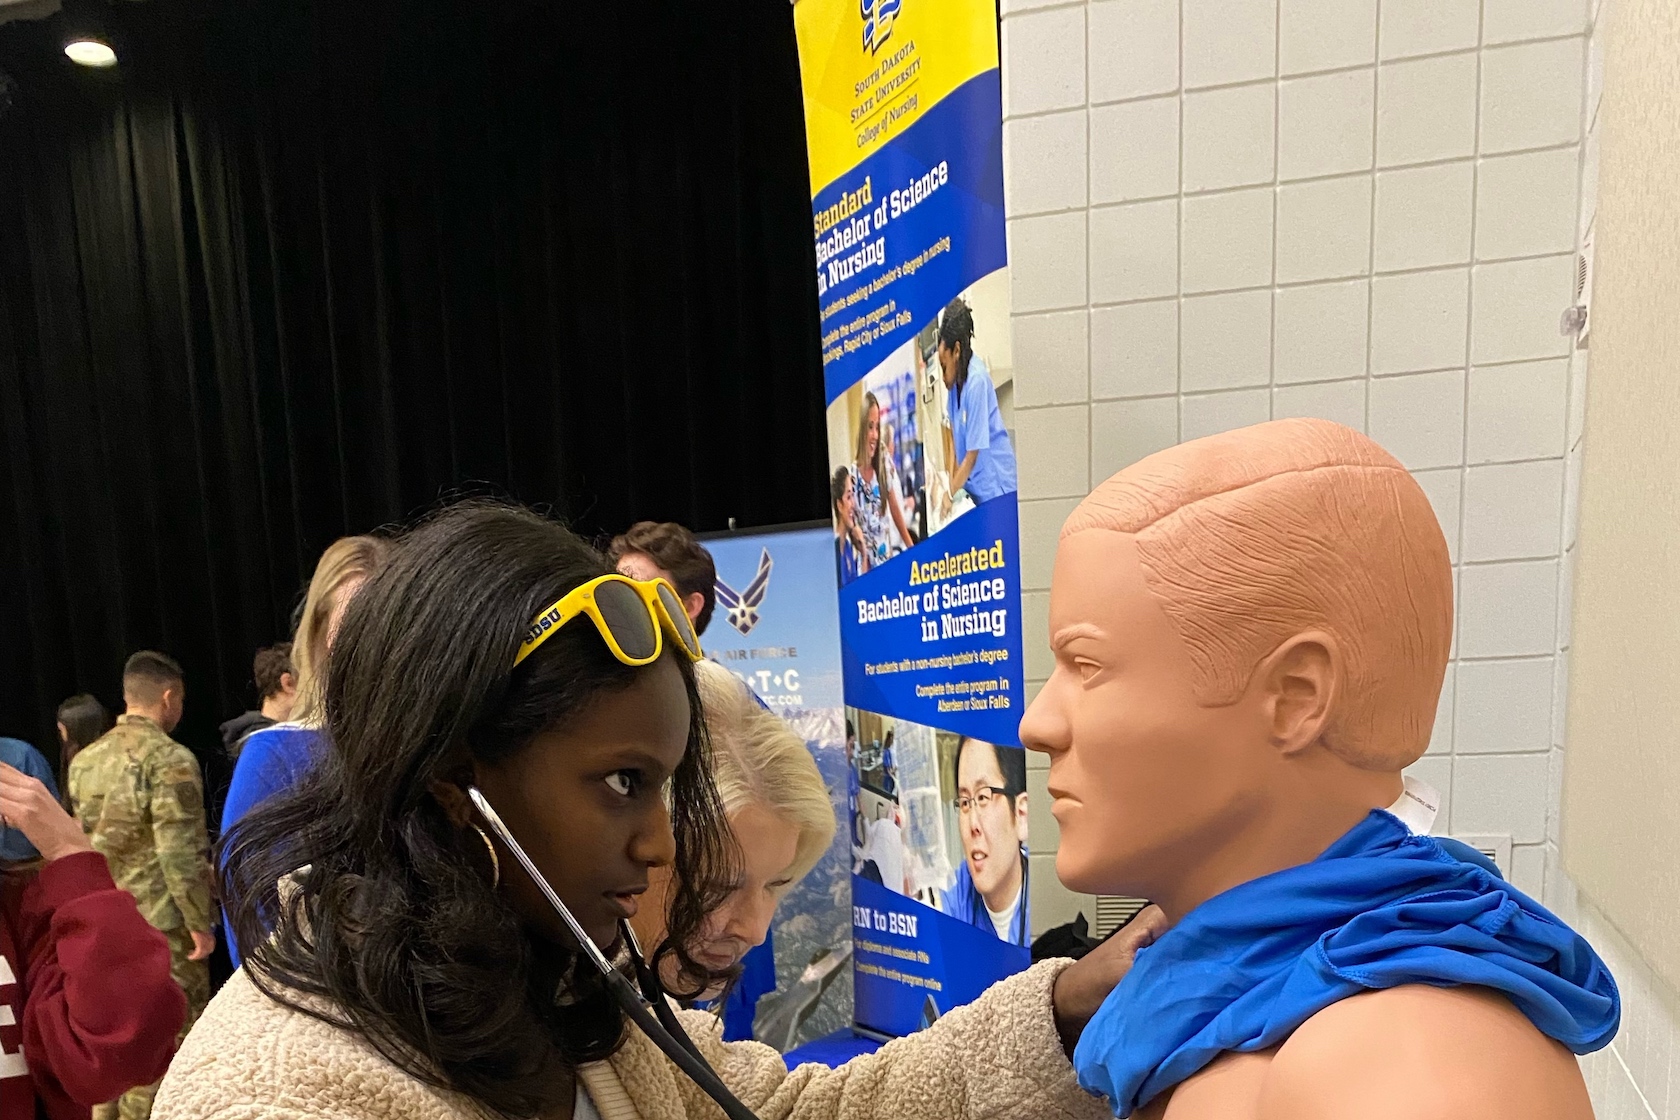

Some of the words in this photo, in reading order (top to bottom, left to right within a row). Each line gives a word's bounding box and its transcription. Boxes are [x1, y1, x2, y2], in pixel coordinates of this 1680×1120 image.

[850, 97, 874, 124] STATE
[875, 56, 921, 103] UNIVERSITY
[854, 68, 880, 98] SOUTH
[882, 40, 915, 75] DAKOTA
[857, 123, 880, 148] College
[881, 111, 888, 132] of
[889, 93, 918, 124] Nursing
[813, 175, 873, 240] Standard
[874, 196, 888, 230] of
[890, 160, 948, 219] Science
[828, 236, 885, 288] Nursing
[902, 254, 923, 275] degree
[928, 236, 950, 257] nursing
[844, 334, 861, 353] Rapid
[861, 330, 872, 345] City
[896, 310, 912, 327] Falls
[865, 304, 889, 328] program
[909, 539, 1005, 586] Accelerated
[857, 591, 920, 624] Bachelor
[923, 585, 939, 612] of
[942, 577, 1006, 609] Science
[921, 616, 939, 642] in
[941, 607, 1007, 639] Nursing
[725, 649, 747, 660] AIR
[865, 663, 875, 675] For
[876, 660, 899, 675] students
[899, 658, 911, 671] with
[916, 654, 952, 670] non-nursing
[979, 648, 1009, 666] degree
[915, 683, 945, 699] Complete
[945, 681, 955, 694] the
[955, 680, 969, 693] entire
[970, 680, 998, 696] program
[999, 676, 1010, 690] in
[937, 699, 963, 712] Aberdeen
[970, 696, 988, 711] Sioux
[988, 694, 1010, 709] Falls
[853, 906, 871, 929] RN
[873, 909, 886, 932] to
[888, 912, 917, 938] BSN
